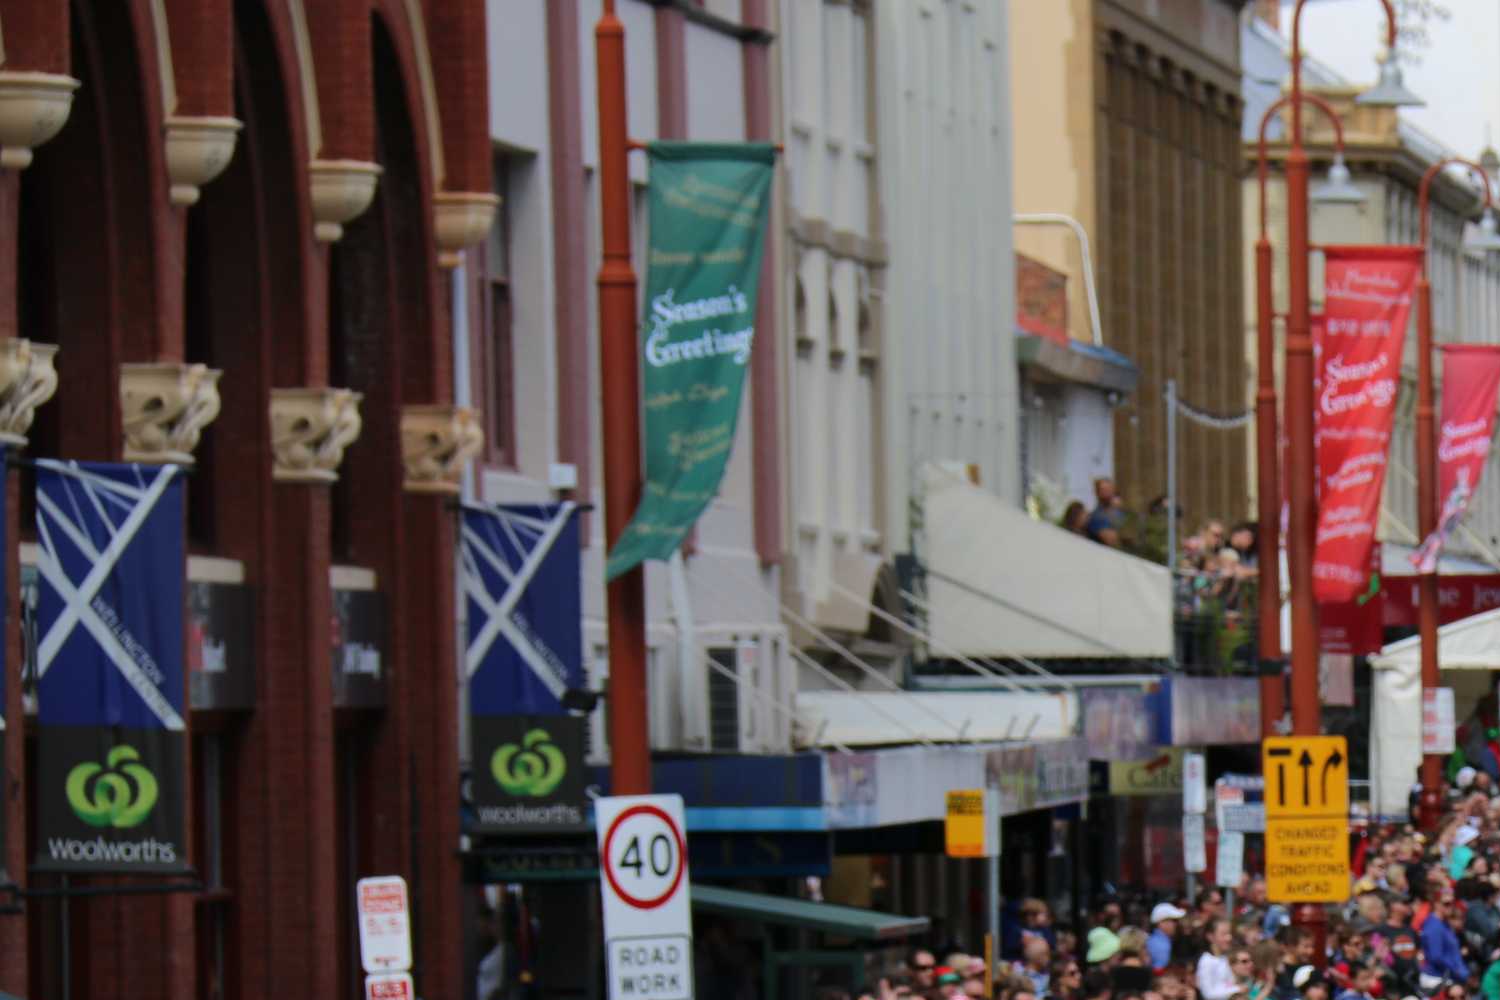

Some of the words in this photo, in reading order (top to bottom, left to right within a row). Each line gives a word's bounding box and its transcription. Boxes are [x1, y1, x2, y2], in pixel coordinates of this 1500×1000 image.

[652, 284, 748, 324] Season's
[619, 833, 672, 878] 40
[620, 946, 680, 966] ROAD
[621, 973, 682, 994] WORK
